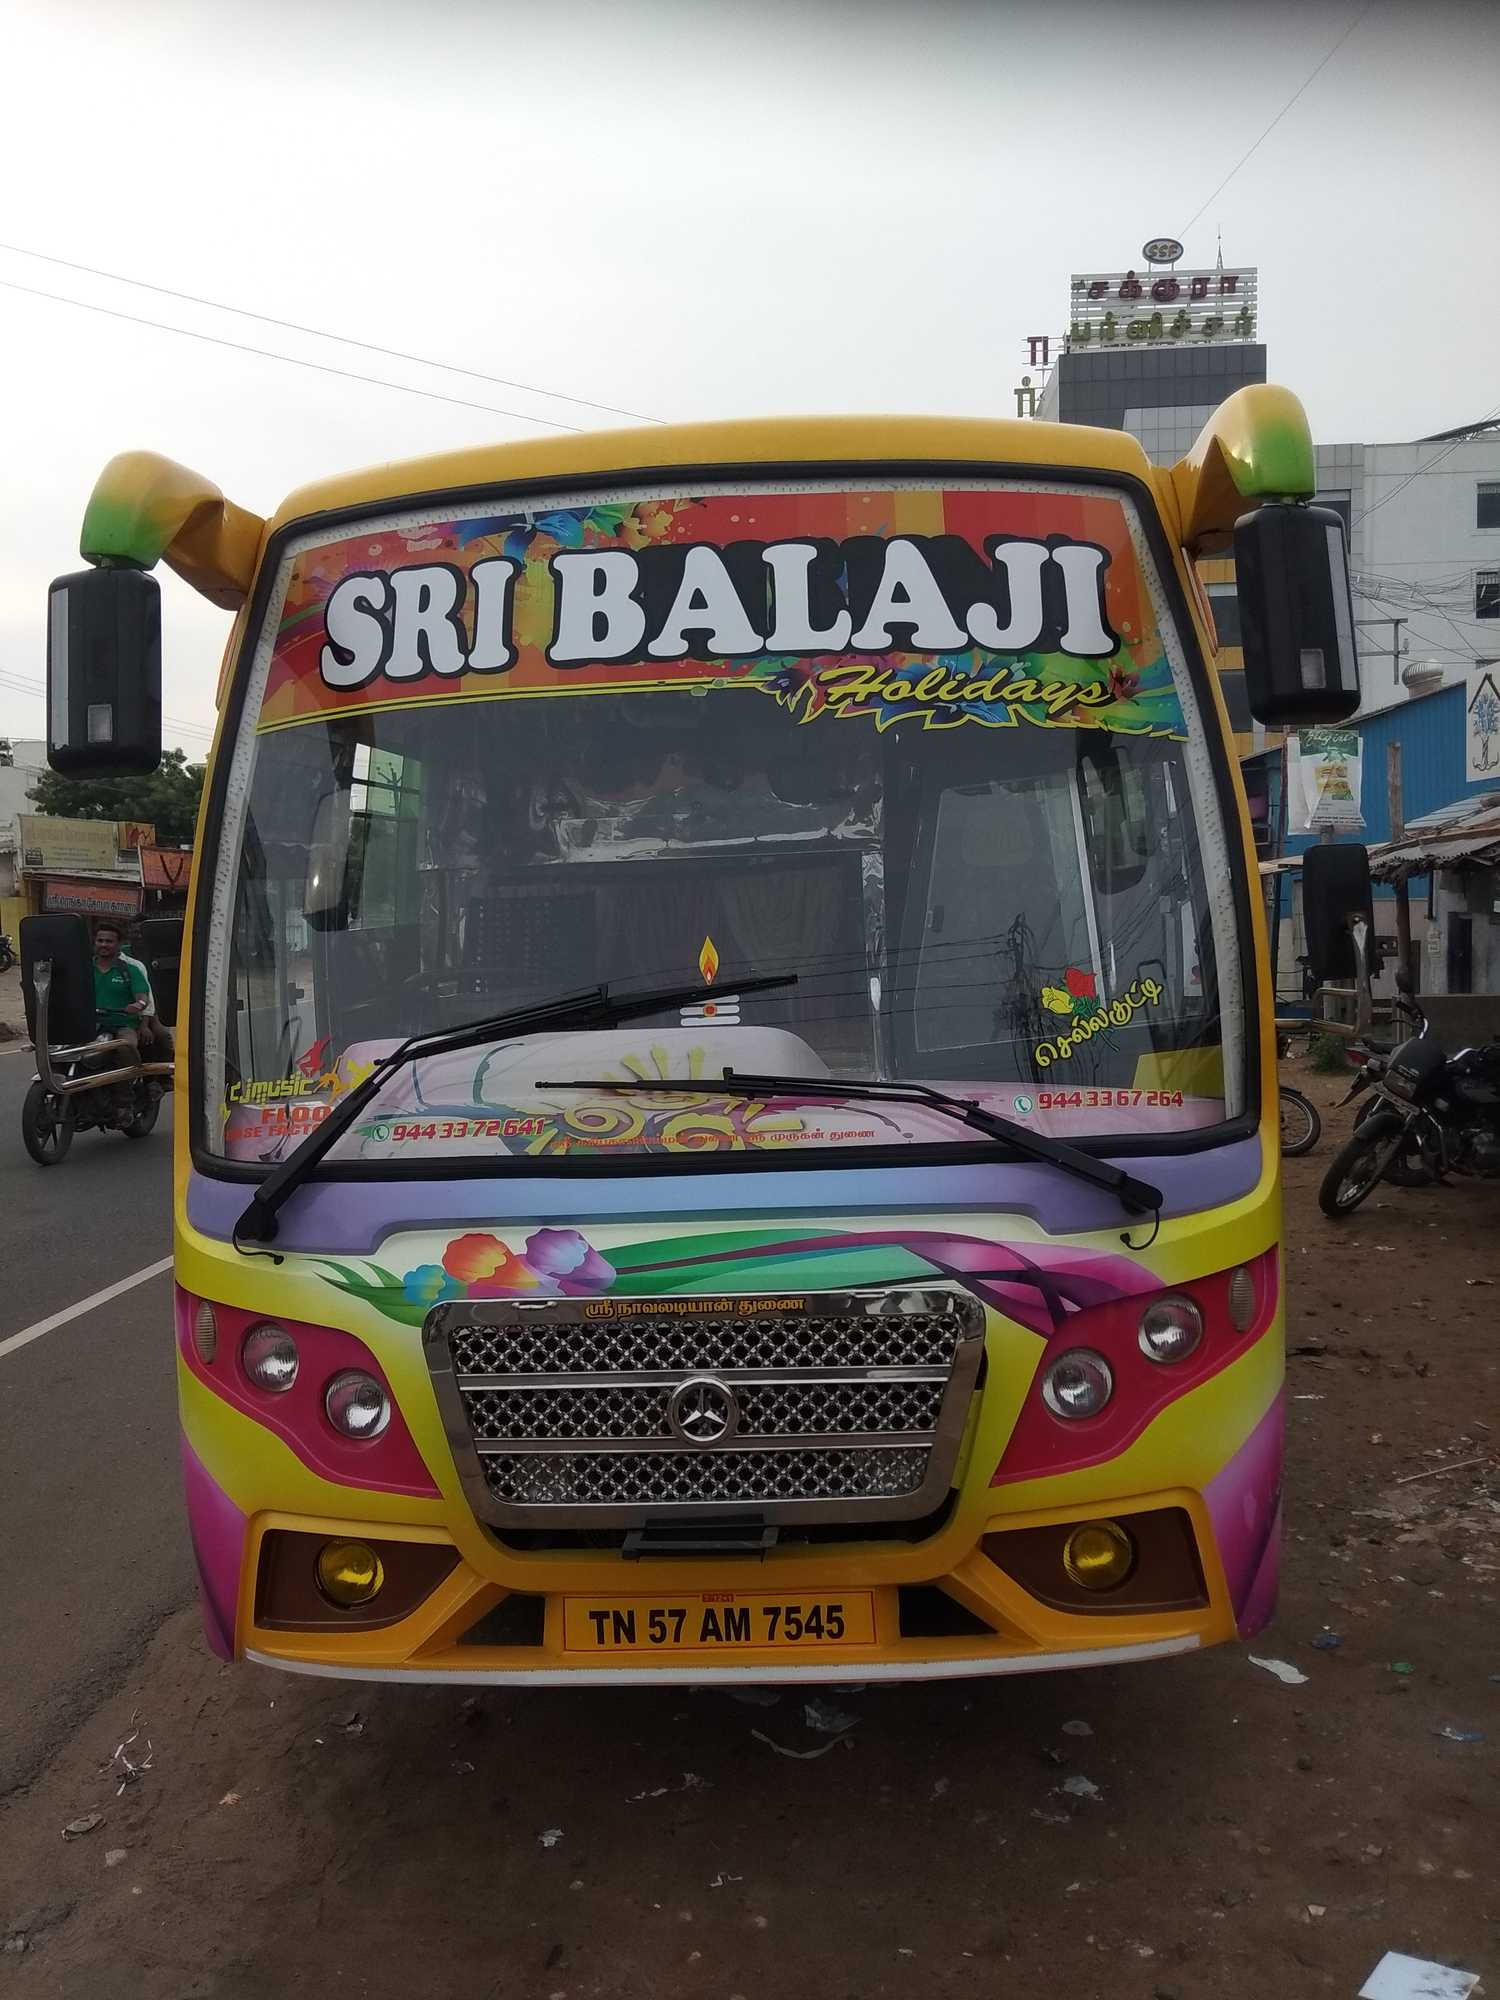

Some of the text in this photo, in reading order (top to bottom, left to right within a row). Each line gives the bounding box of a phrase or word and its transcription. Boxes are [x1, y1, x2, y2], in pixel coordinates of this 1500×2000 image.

[320, 537, 1120, 688] SRI BALAJI
[826, 664, 1113, 709] Holidays
[737, 1297, 805, 1316] துணை
[589, 1604, 846, 1645] TN 57 AM 7545
